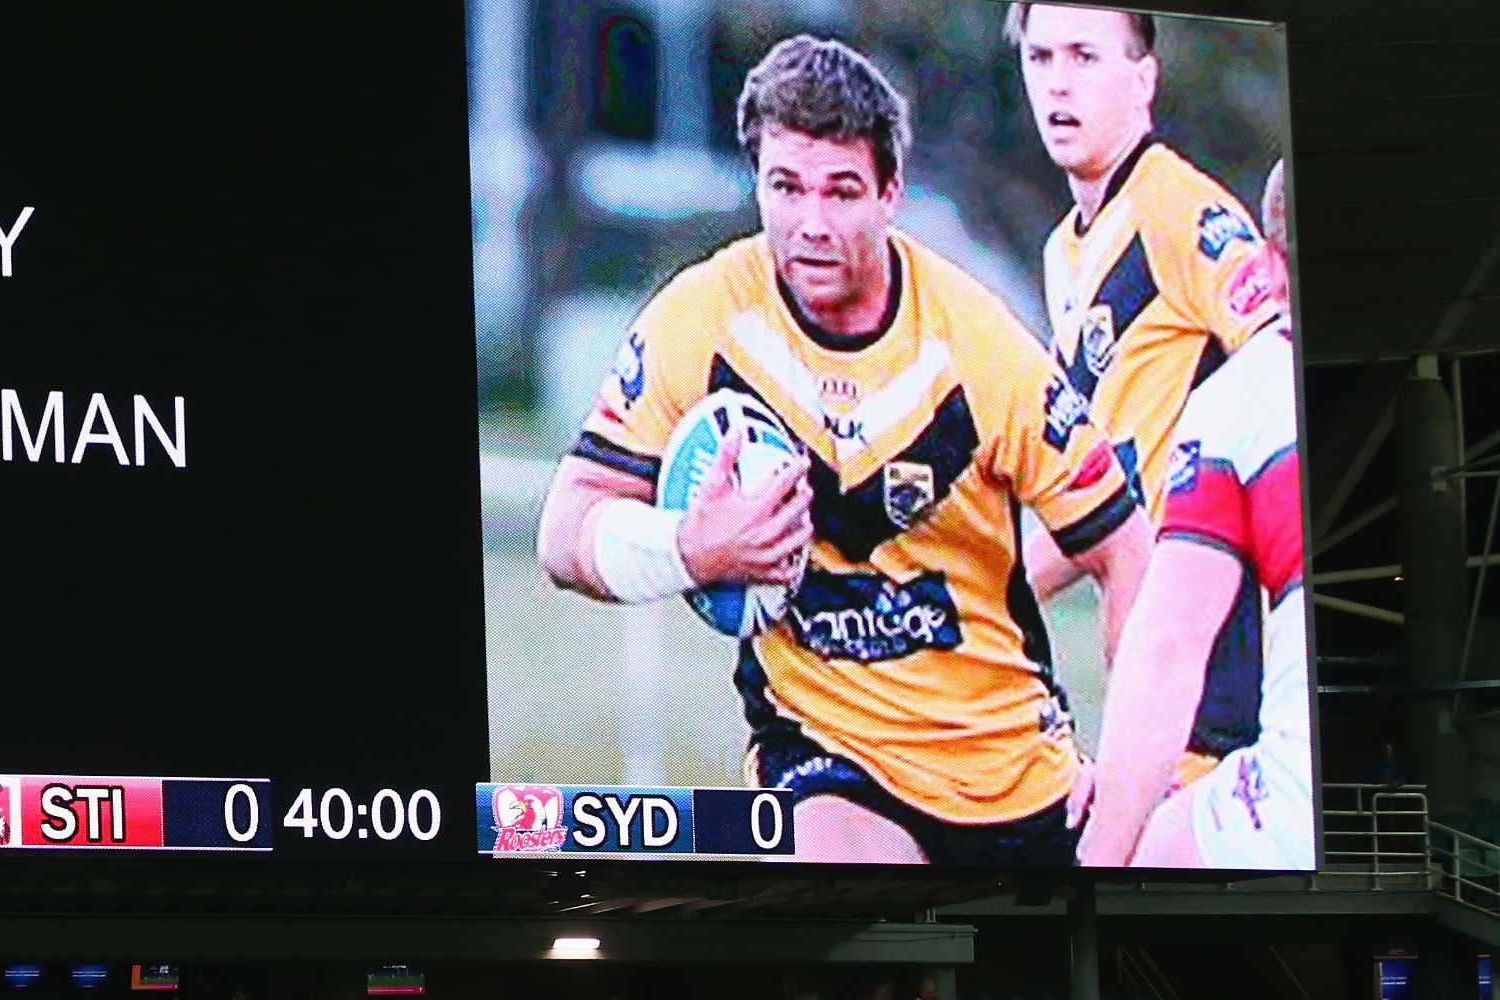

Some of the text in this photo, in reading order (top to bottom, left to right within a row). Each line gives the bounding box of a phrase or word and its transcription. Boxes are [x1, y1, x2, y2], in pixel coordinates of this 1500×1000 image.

[39, 785, 124, 841] STI
[224, 783, 261, 840] 0
[283, 787, 442, 842] 40:00
[572, 795, 679, 847] SYD
[749, 795, 784, 851] 0
